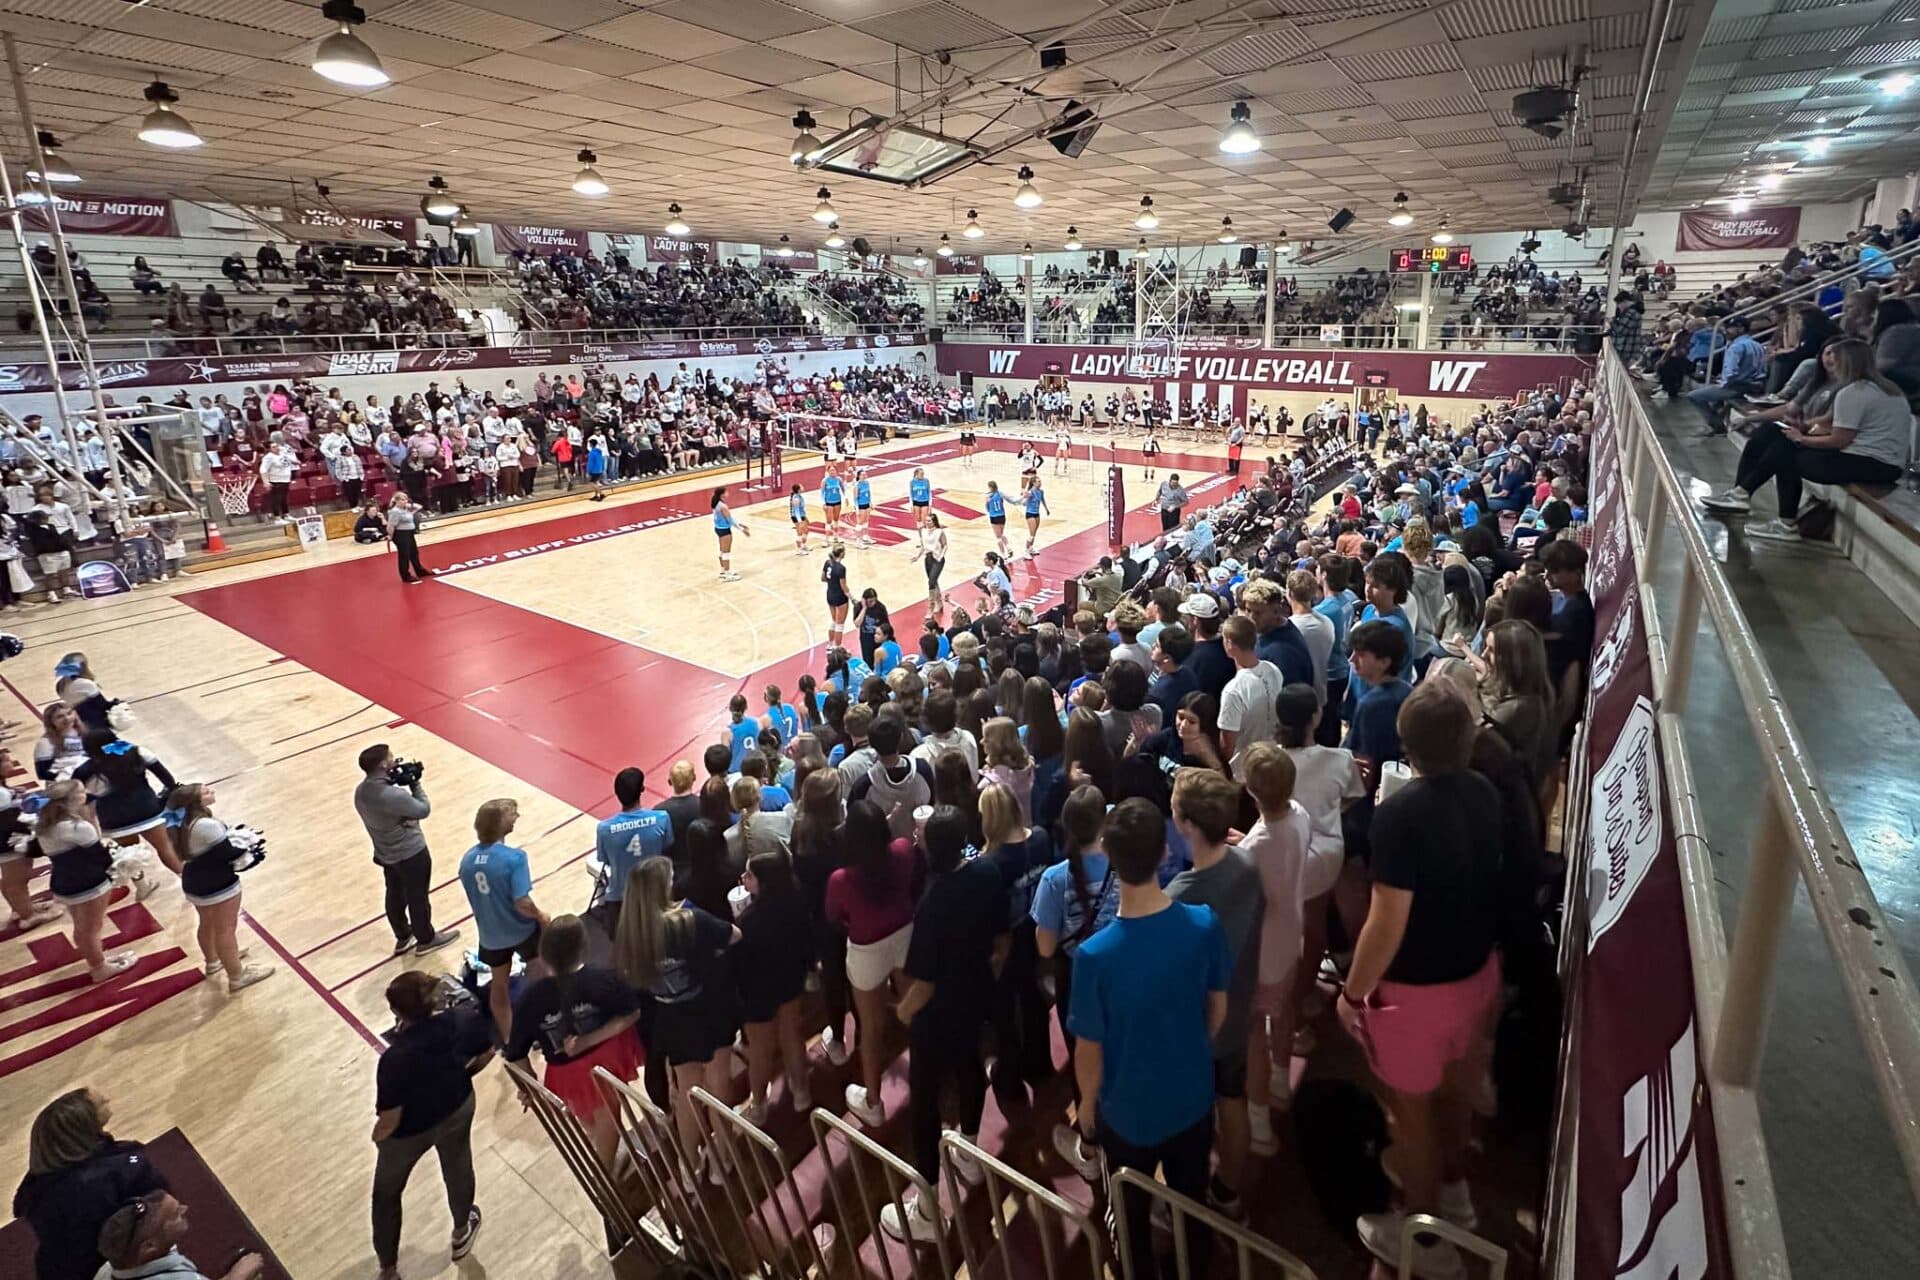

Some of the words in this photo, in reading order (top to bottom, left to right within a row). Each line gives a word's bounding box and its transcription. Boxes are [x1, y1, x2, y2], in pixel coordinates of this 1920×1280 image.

[103, 202, 165, 217] MOTION
[519, 225, 542, 236] LADY
[542, 227, 565, 237] BUFF
[1719, 226, 1780, 238] VOLLEYBALL
[527, 235, 578, 247] VOLLEYBALL
[653, 238, 679, 251] LADY
[1400, 254, 1408, 267] 0
[1422, 247, 1447, 260] 1:00
[1431, 262, 1440, 272] 2
[339, 353, 372, 364] PAK
[988, 350, 1021, 374] WT
[356, 363, 392, 374] SAK
[1069, 353, 1126, 377] LADY
[1194, 357, 1354, 386] VOLLEYBALL
[1428, 360, 1488, 393] WT
[431, 553, 499, 576] LADY
[502, 539, 567, 560] BUFF
[568, 512, 693, 545] VOLLEYBALL
[782, 716, 793, 738] 7
[610, 815, 657, 834] BROOKLYN
[626, 833, 643, 857] 4
[474, 871, 491, 895] 8
